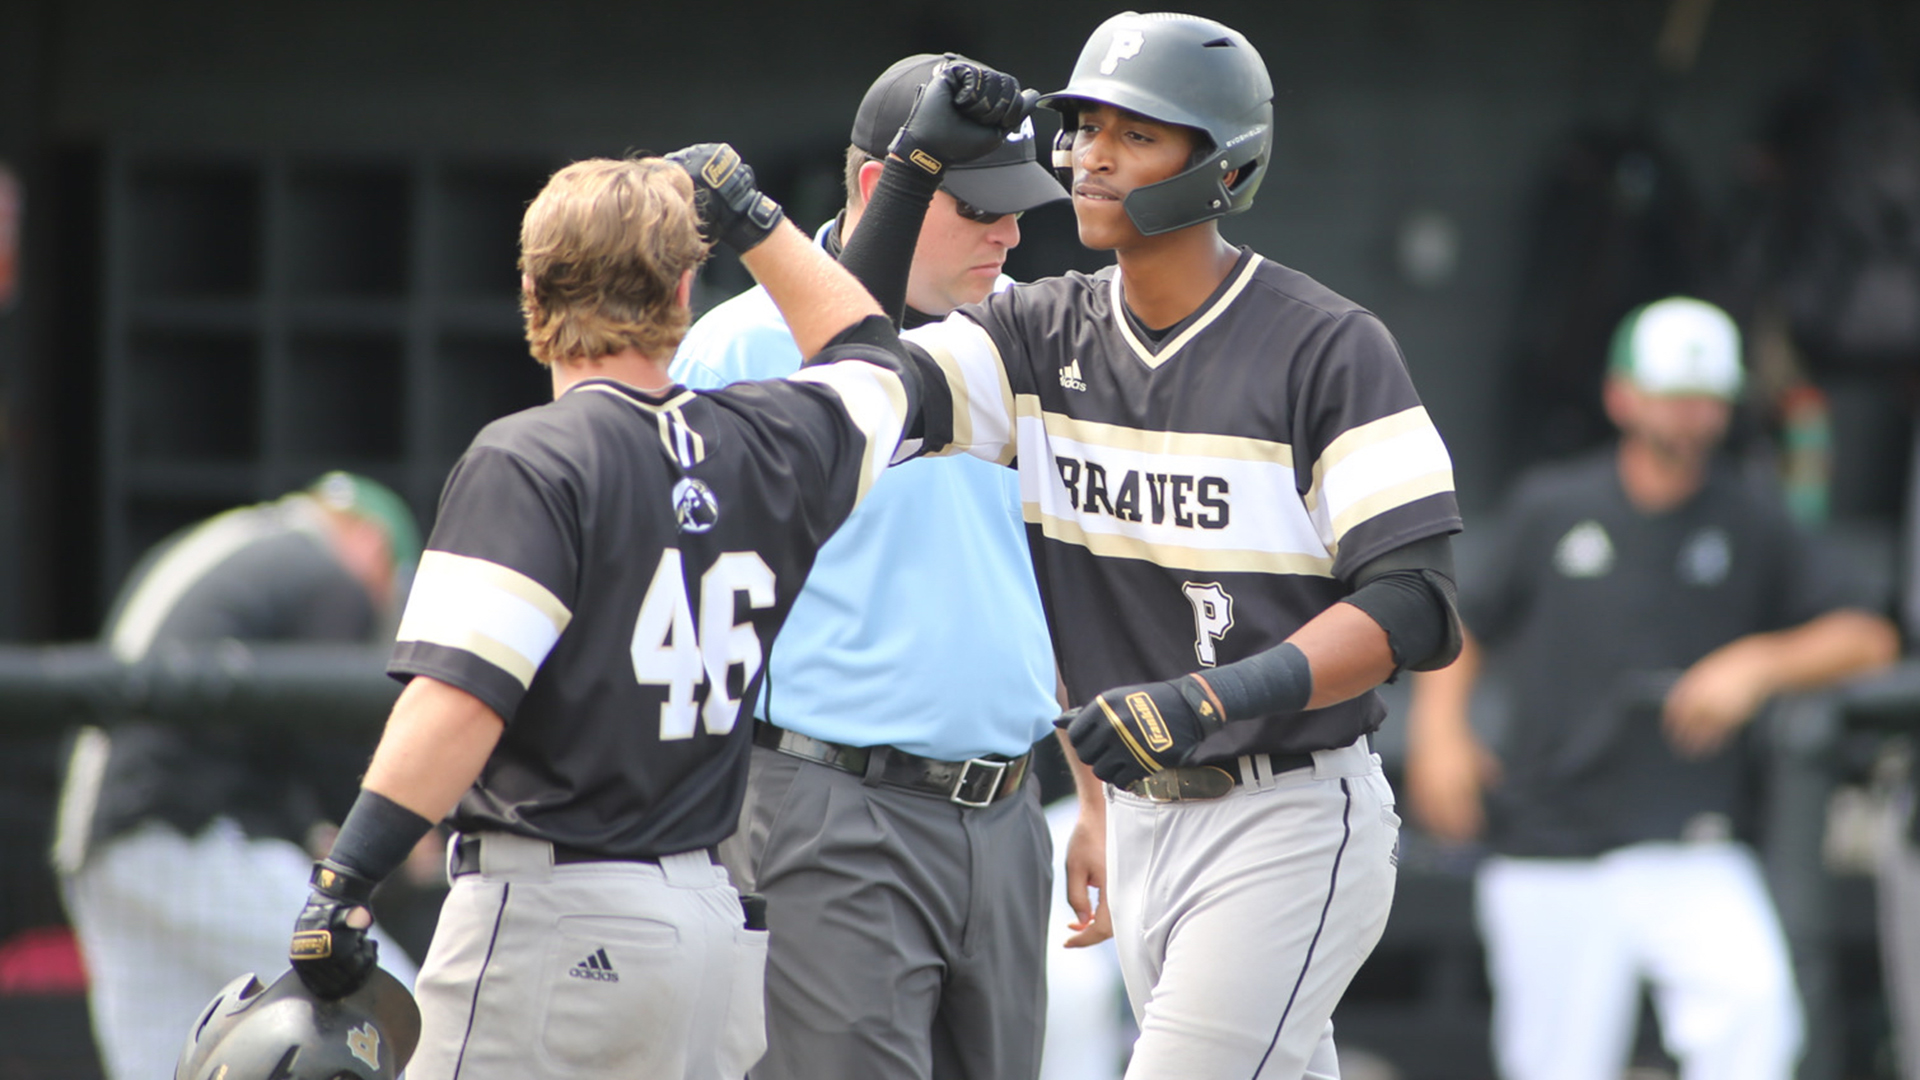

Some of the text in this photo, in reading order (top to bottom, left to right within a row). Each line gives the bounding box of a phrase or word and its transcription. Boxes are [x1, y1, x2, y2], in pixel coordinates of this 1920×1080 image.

[1100, 29, 1146, 76] P
[1055, 455, 1231, 530] BRAVES
[630, 547, 777, 741] 46
[1181, 580, 1235, 668] P
[569, 966, 620, 984] adidas
